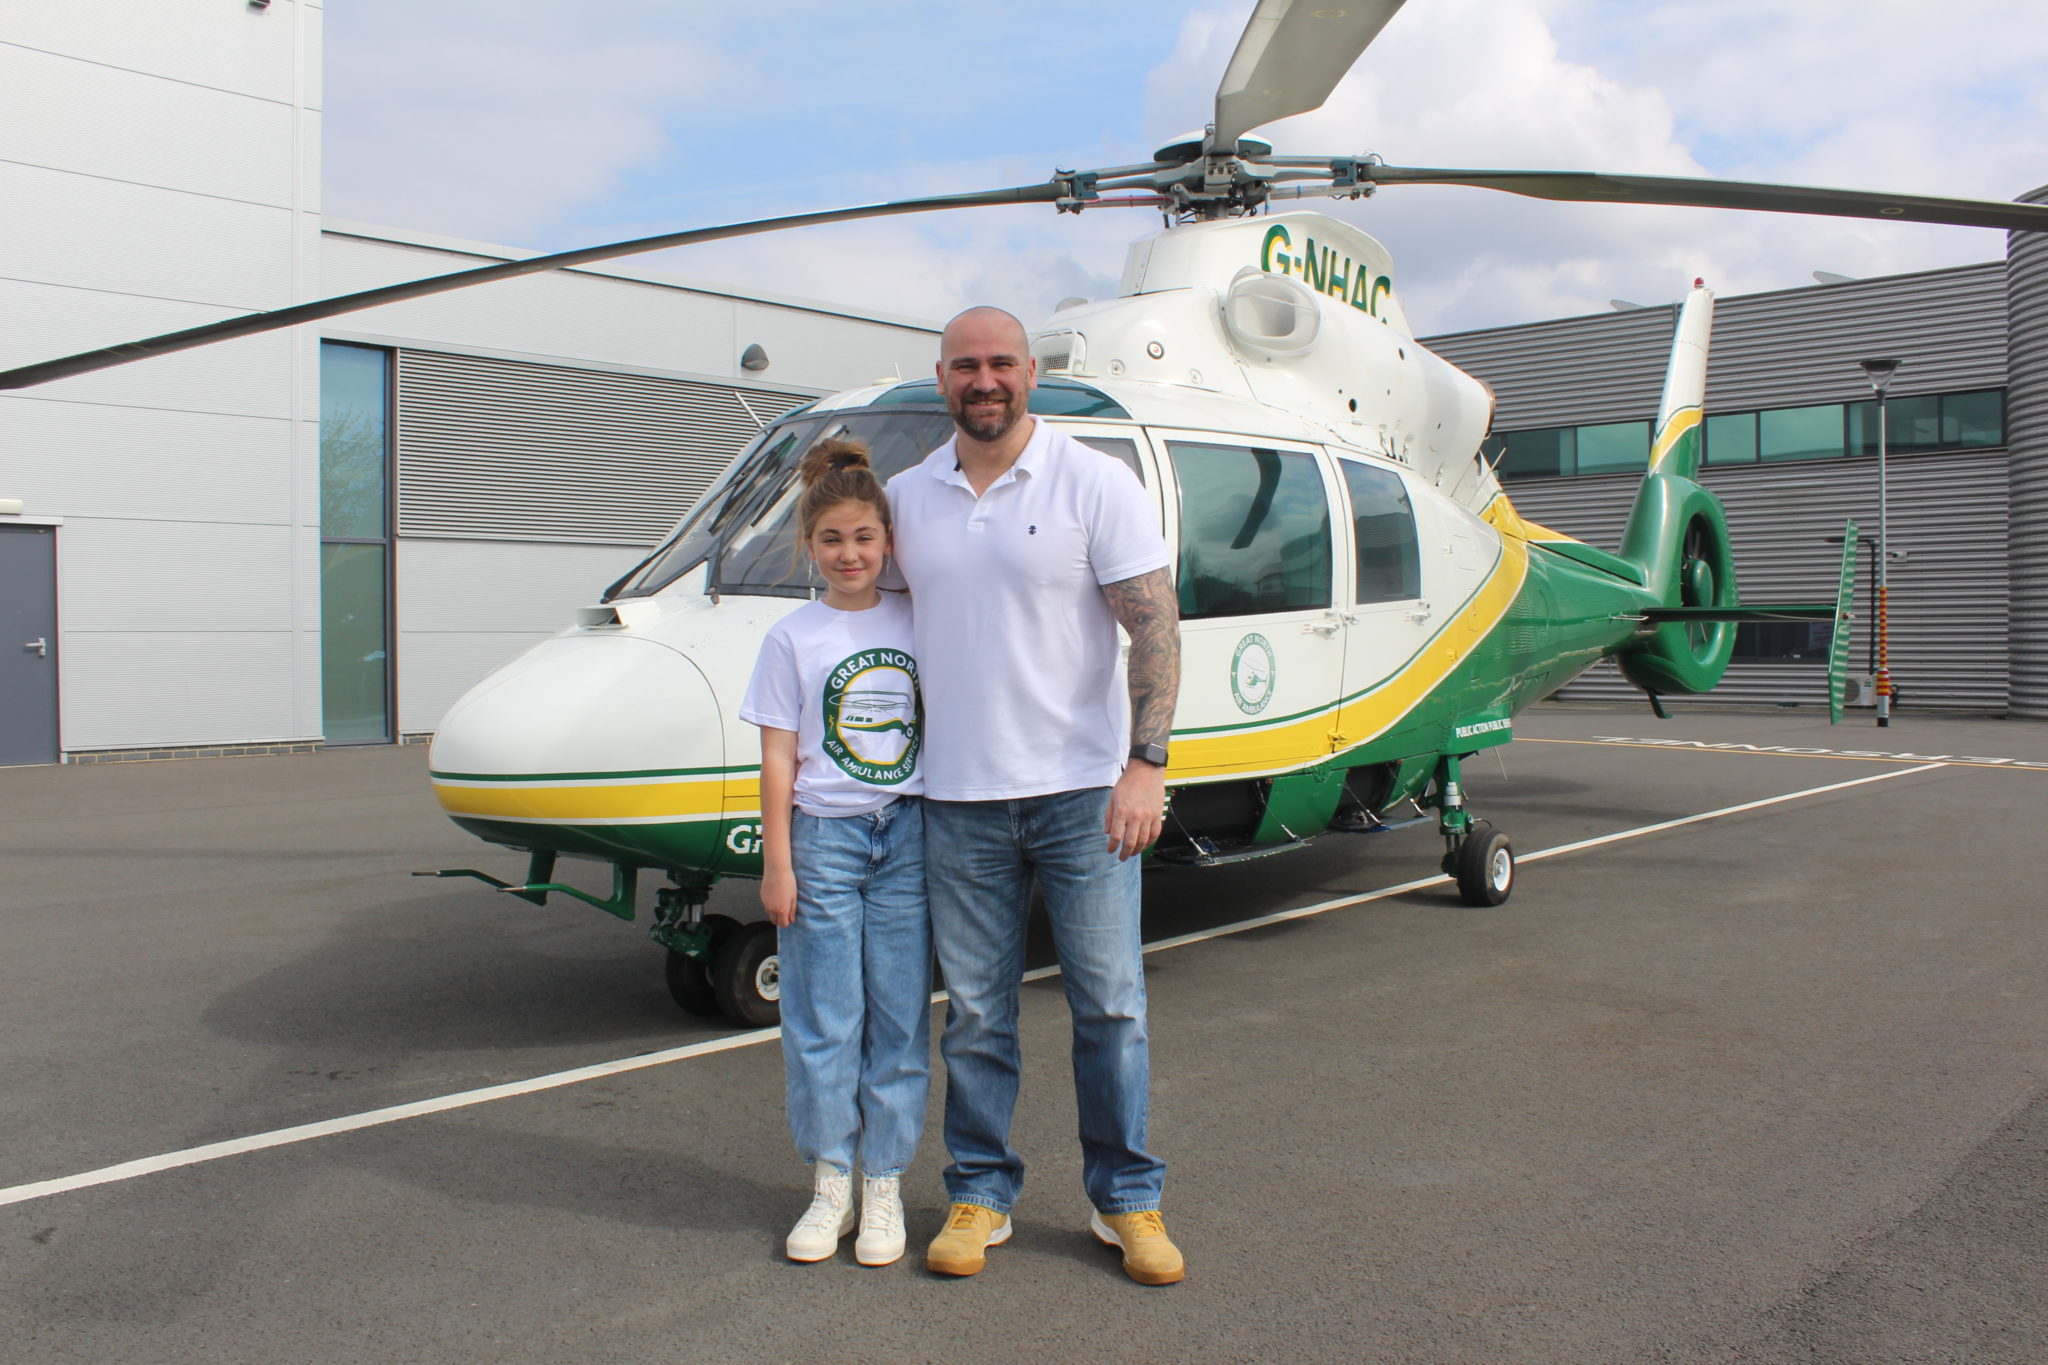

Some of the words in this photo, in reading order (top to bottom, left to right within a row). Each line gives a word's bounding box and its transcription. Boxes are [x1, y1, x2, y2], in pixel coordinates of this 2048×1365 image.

[1260, 223, 1391, 325] G-NHAC
[1235, 635, 1254, 657] GREAT
[1254, 635, 1273, 657] NORTH
[831, 653, 876, 689] GREAT
[1456, 726, 1473, 738] PUBLIC
[826, 740, 844, 757] AIR
[904, 735, 919, 772] SERVICE
